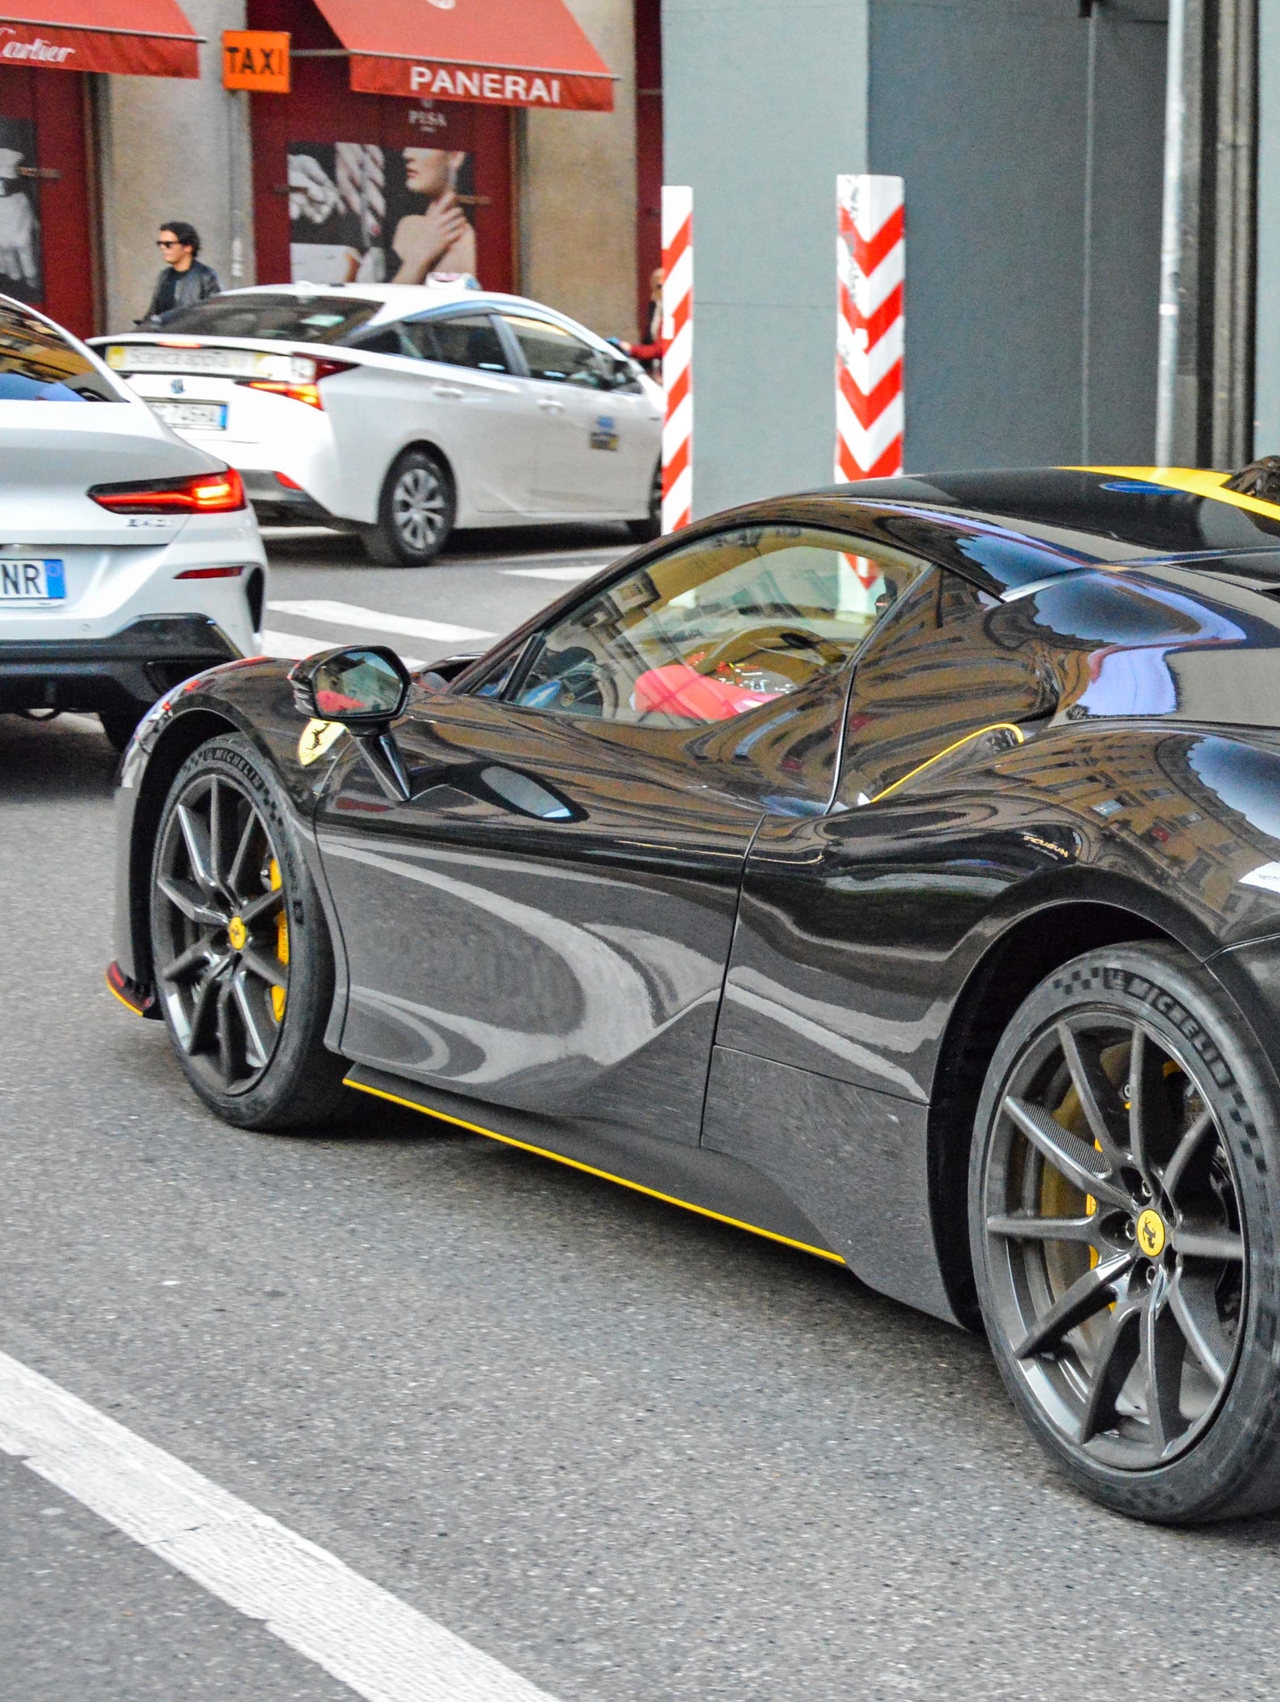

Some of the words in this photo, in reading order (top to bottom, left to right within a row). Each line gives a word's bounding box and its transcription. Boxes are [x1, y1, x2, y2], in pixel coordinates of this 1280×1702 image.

[226, 46, 284, 75] TAXI
[410, 66, 560, 103] PANERAI
[214, 748, 262, 788] MICHELIN
